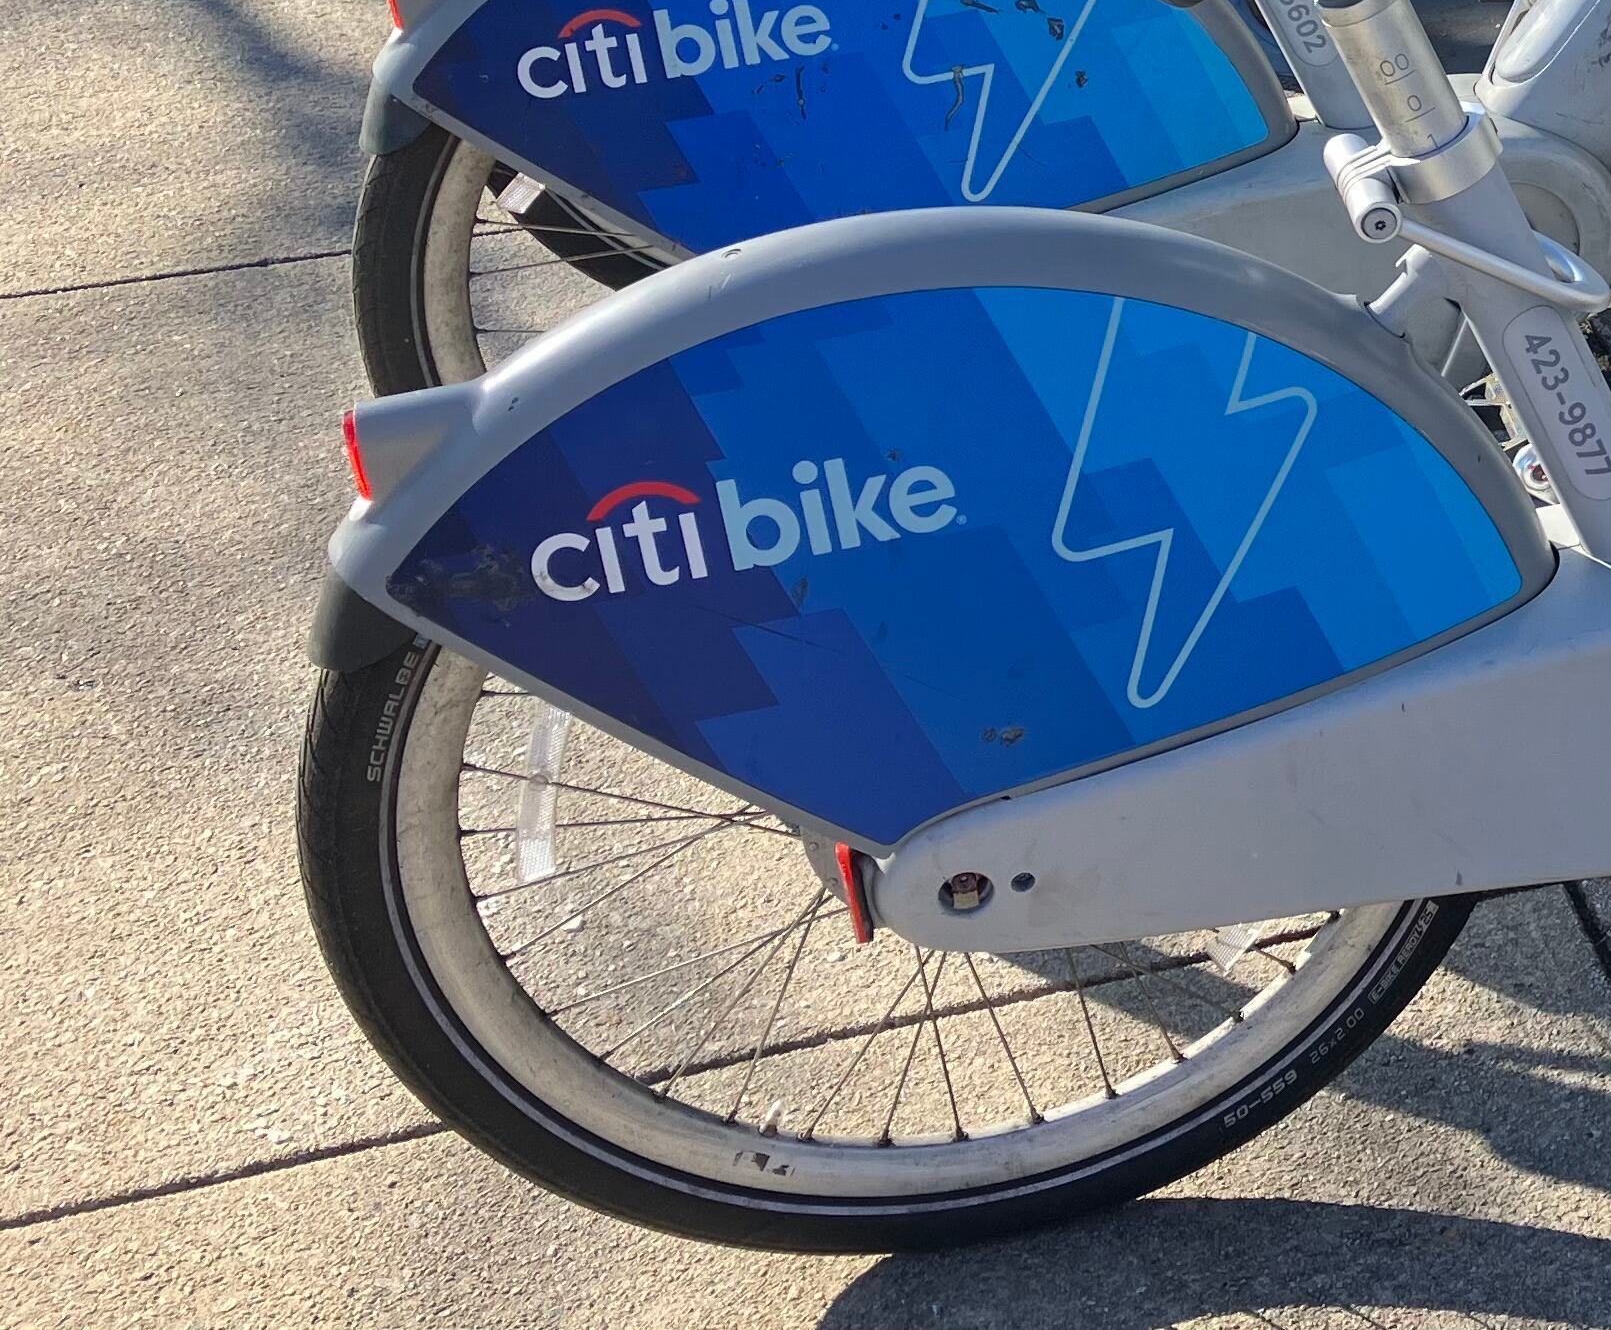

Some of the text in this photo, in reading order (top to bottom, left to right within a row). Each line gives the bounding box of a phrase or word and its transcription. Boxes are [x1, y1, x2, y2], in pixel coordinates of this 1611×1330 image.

[517, 8, 650, 100] citi
[531, 458, 957, 602] citi bike
[367, 651, 421, 784] SCHWALBE
[1222, 1068, 1298, 1129] 50-559
